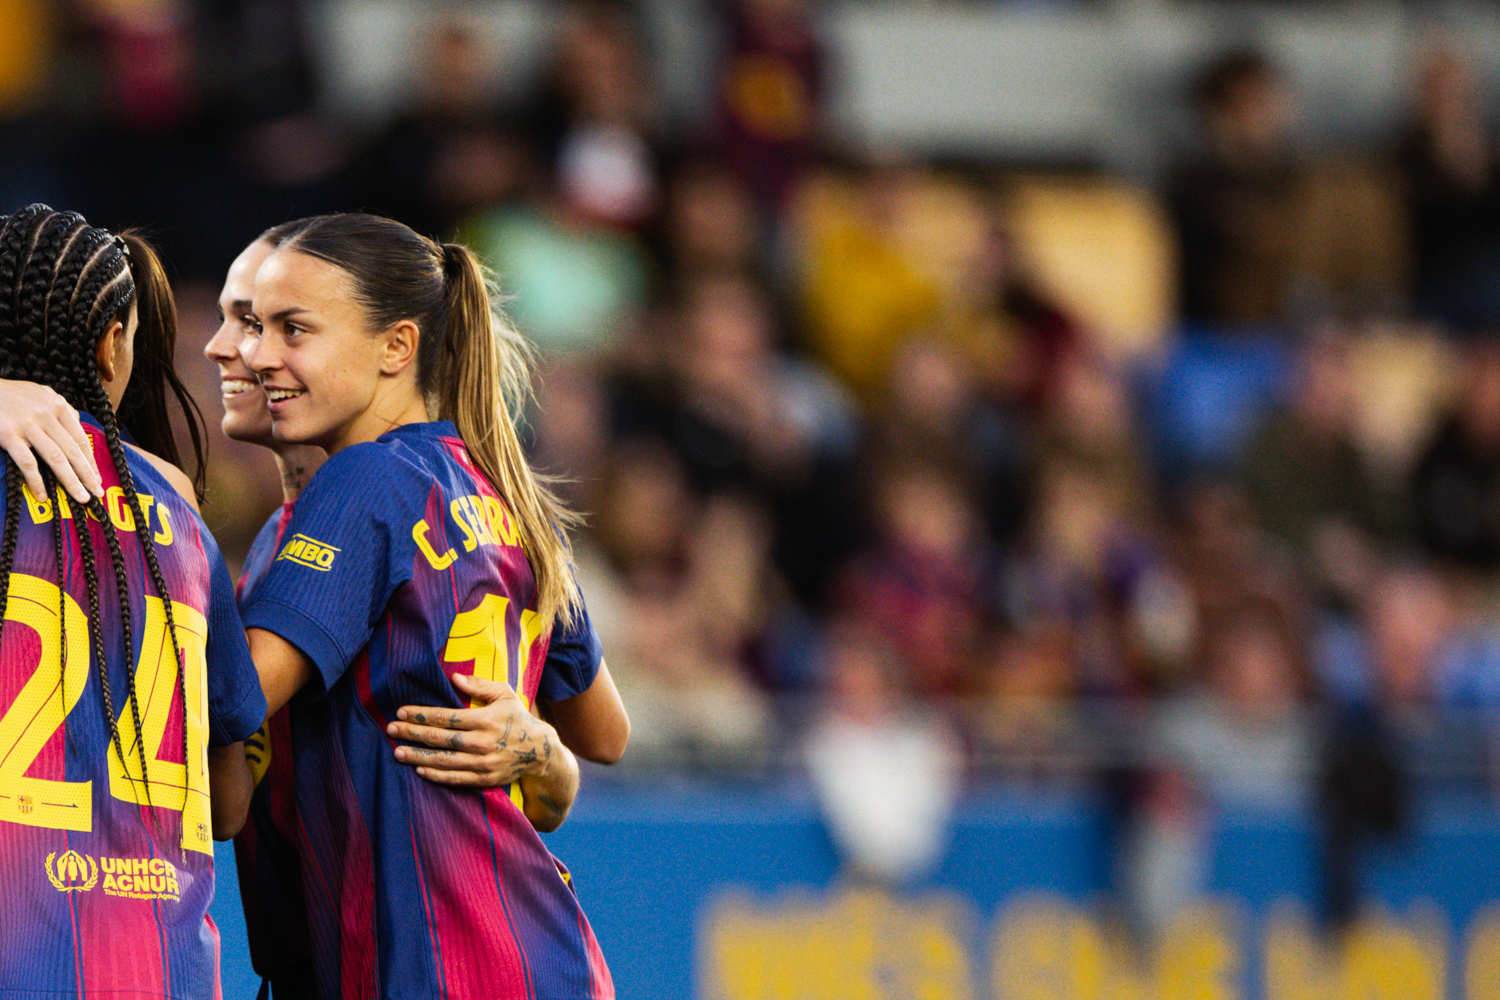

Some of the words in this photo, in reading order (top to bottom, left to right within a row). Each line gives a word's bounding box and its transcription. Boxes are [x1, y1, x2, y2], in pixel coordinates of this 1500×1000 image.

[412, 518, 458, 571] C.
[450, 495, 526, 553] SERRA
[100, 857, 177, 879] UNHCR
[102, 873, 180, 895] ACNUR
[129, 892, 157, 900] Refugee
[158, 893, 180, 903] Agency
